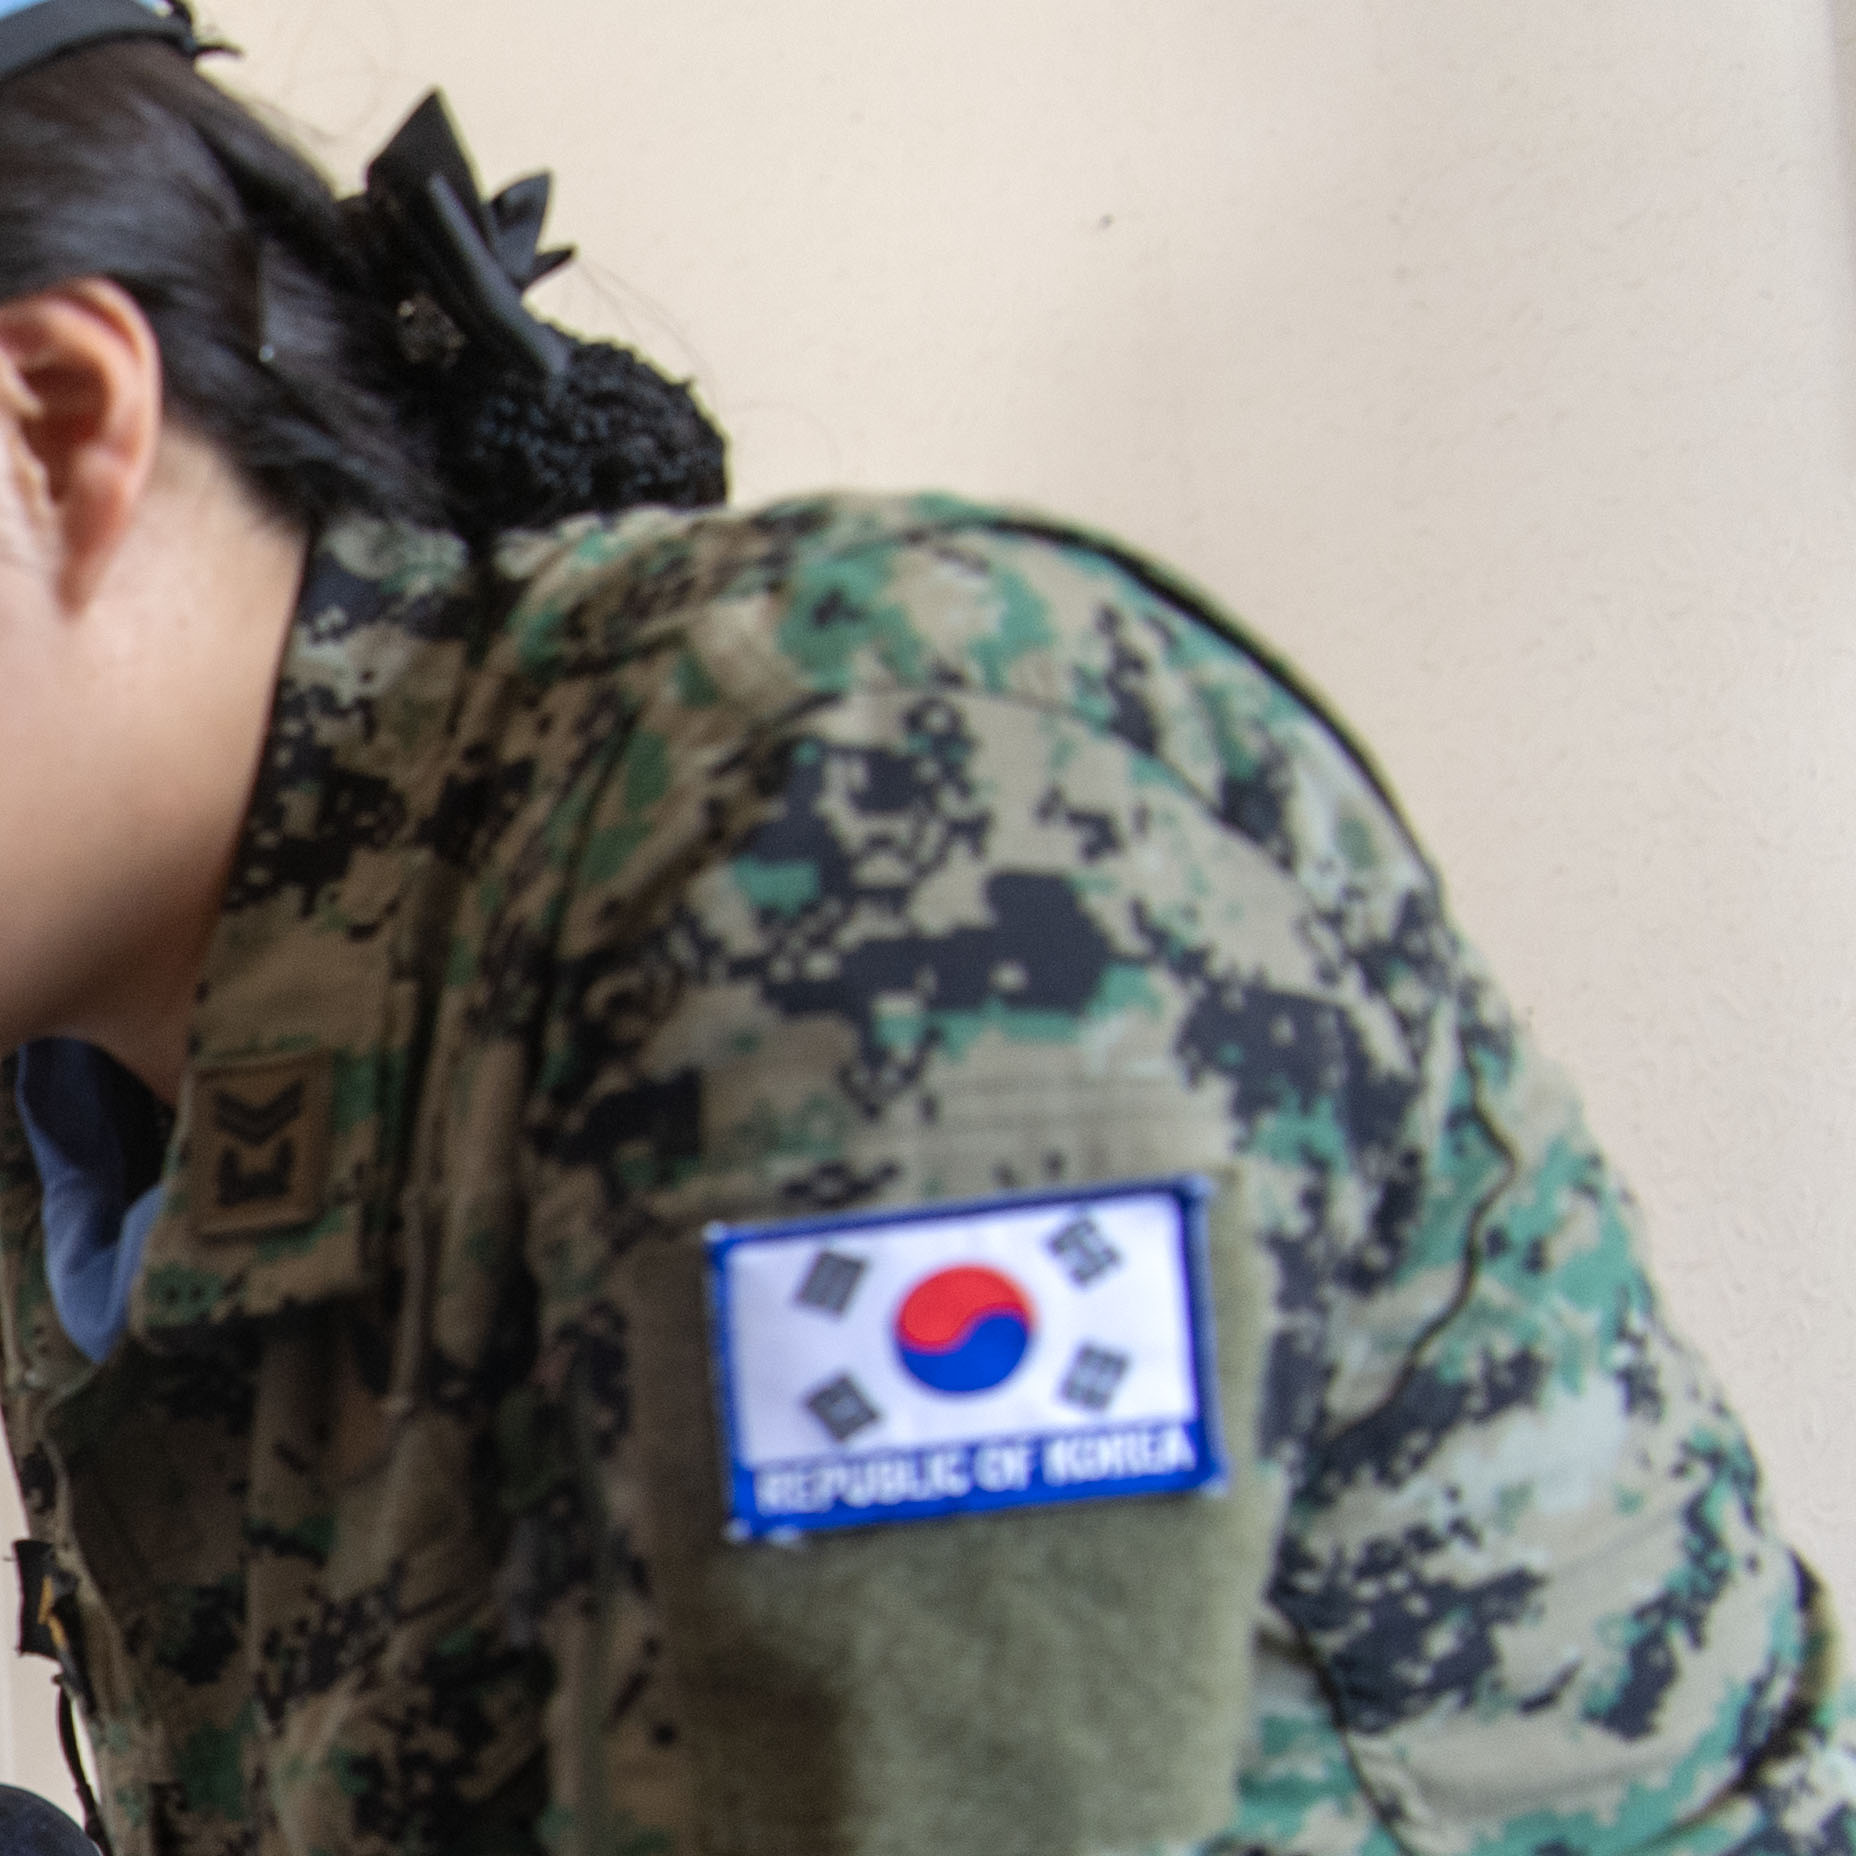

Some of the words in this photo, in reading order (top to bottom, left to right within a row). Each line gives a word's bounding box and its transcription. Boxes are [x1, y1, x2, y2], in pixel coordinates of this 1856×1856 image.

[755, 1448, 971, 1516] REPUBLIC
[974, 1444, 1033, 1491] OF
[1042, 1425, 1197, 1486] KOREA
